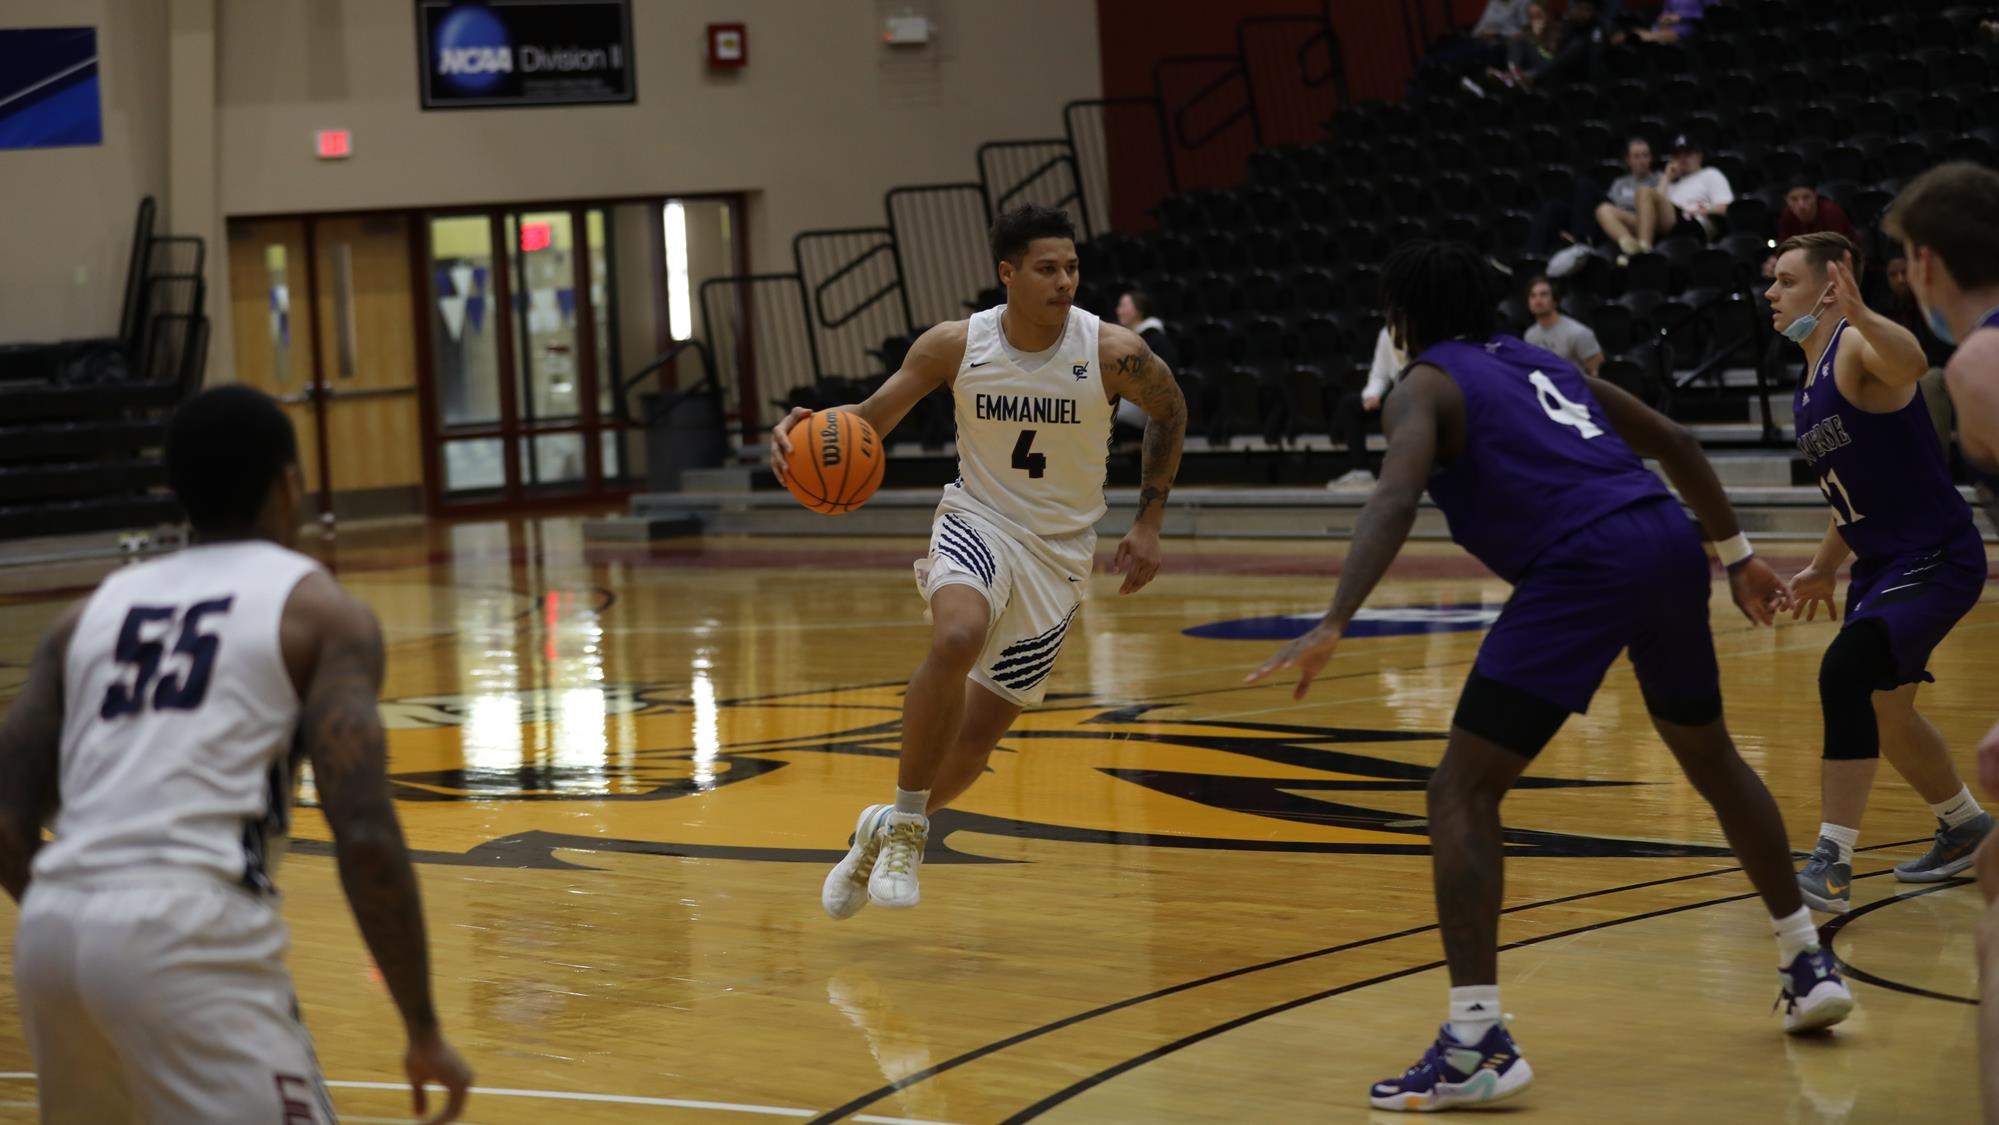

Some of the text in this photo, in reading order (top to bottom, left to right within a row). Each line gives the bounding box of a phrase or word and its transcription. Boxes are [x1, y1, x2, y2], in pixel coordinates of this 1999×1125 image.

[438, 46, 514, 75] NCAA
[519, 44, 607, 72] Division
[976, 393, 1081, 424] EMMANUEL
[1528, 369, 1605, 440] 4
[821, 411, 841, 468] Wilson
[1011, 429, 1047, 479] 4
[101, 596, 234, 722] 55
